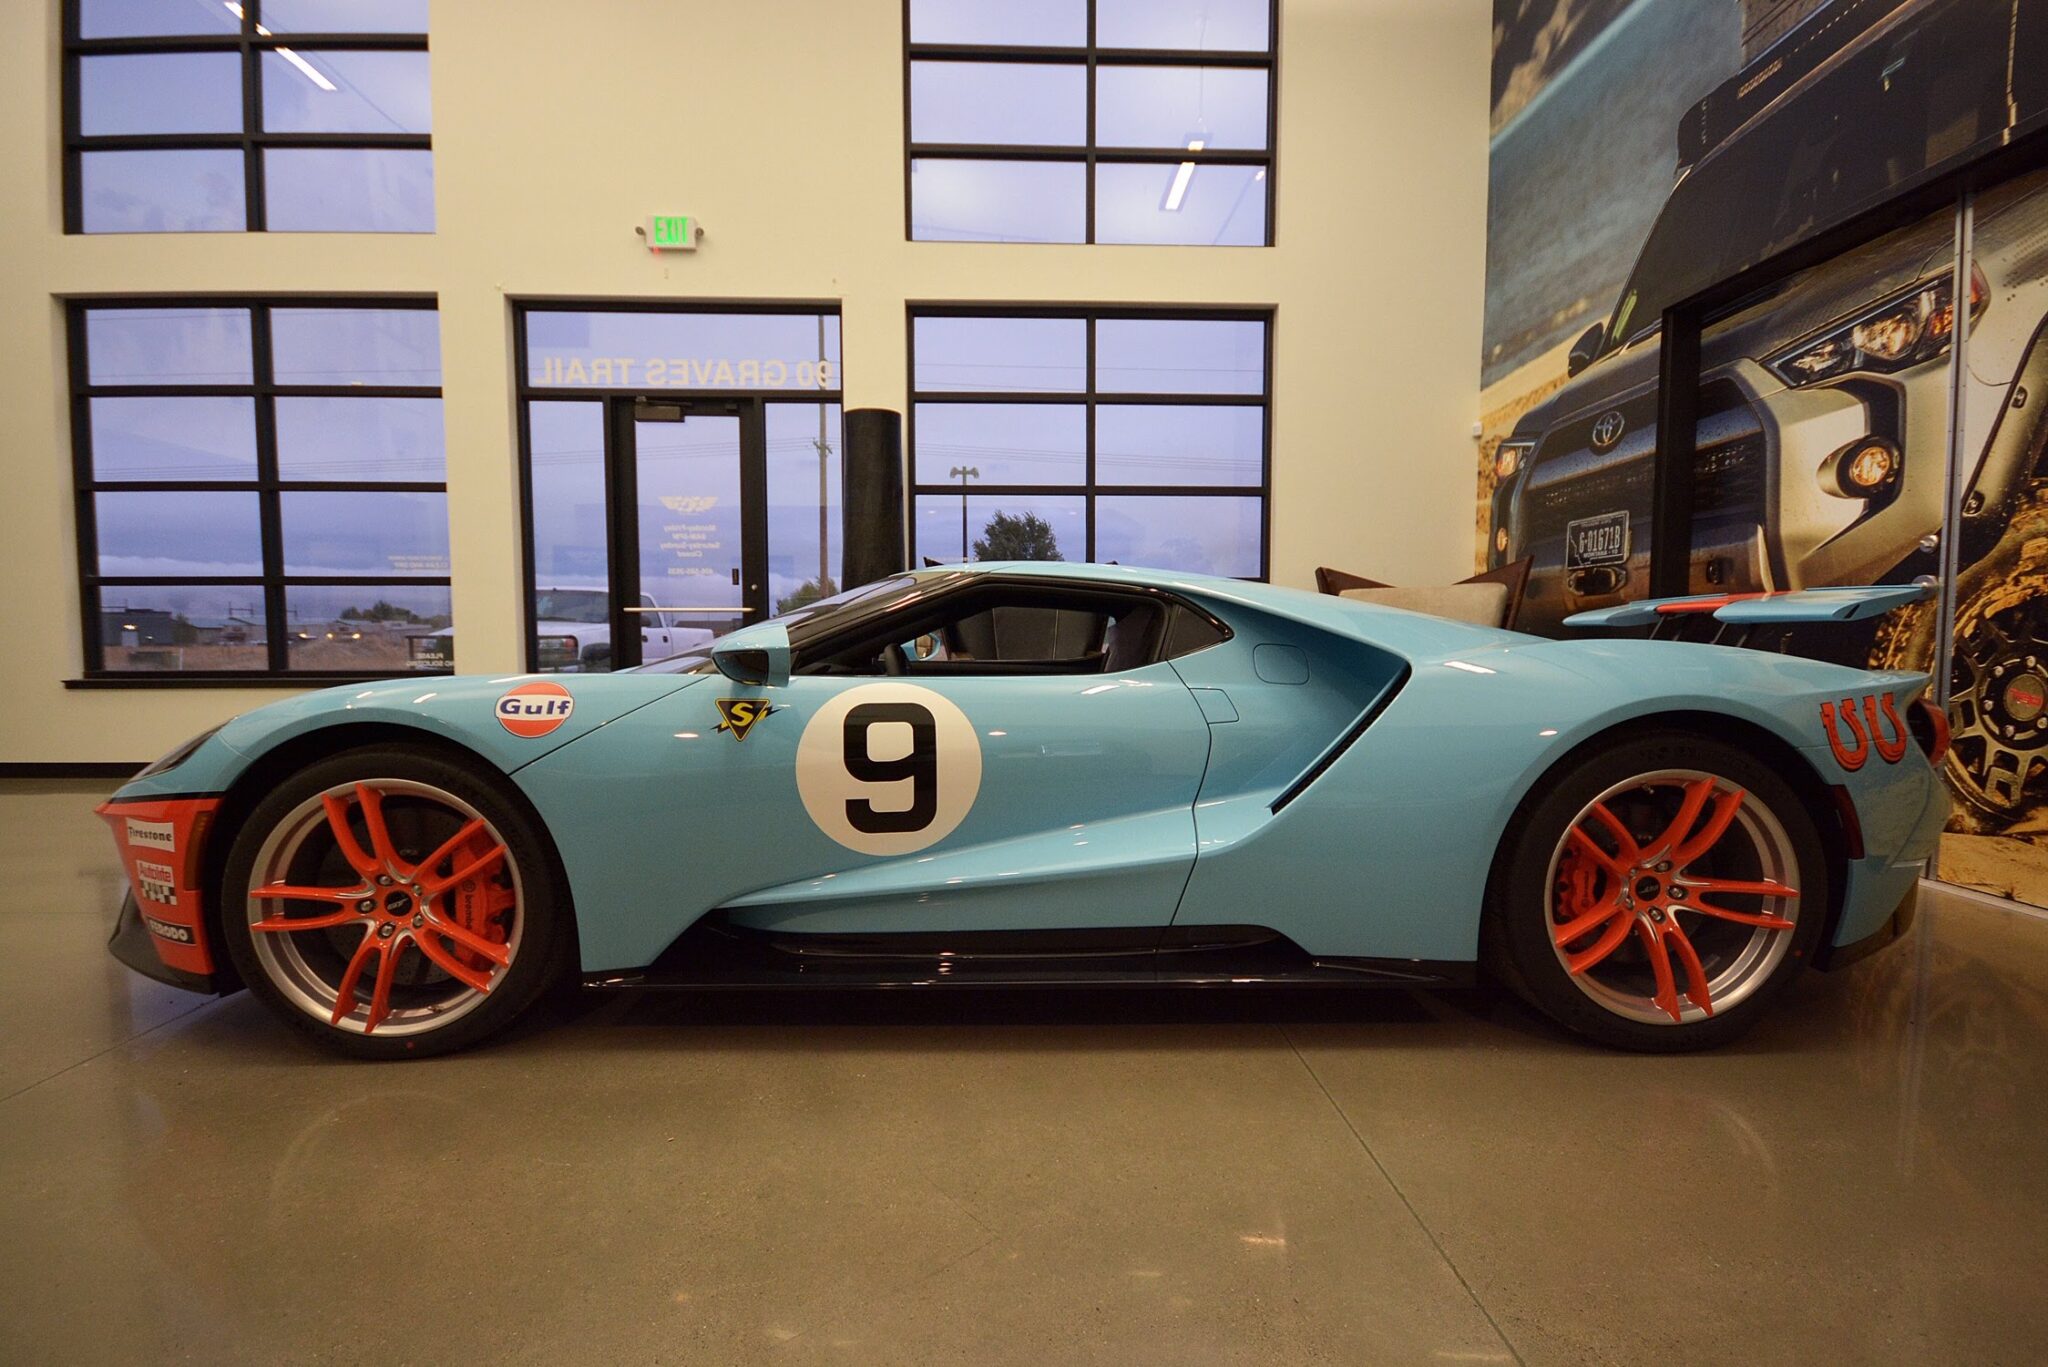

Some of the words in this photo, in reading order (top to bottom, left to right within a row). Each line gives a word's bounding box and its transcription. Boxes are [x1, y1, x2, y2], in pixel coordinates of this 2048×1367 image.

[655, 215, 688, 245] EXIT
[500, 698, 571, 715] Gulf
[731, 702, 754, 727] S
[843, 702, 937, 834] 9
[128, 826, 173, 842] Firestone
